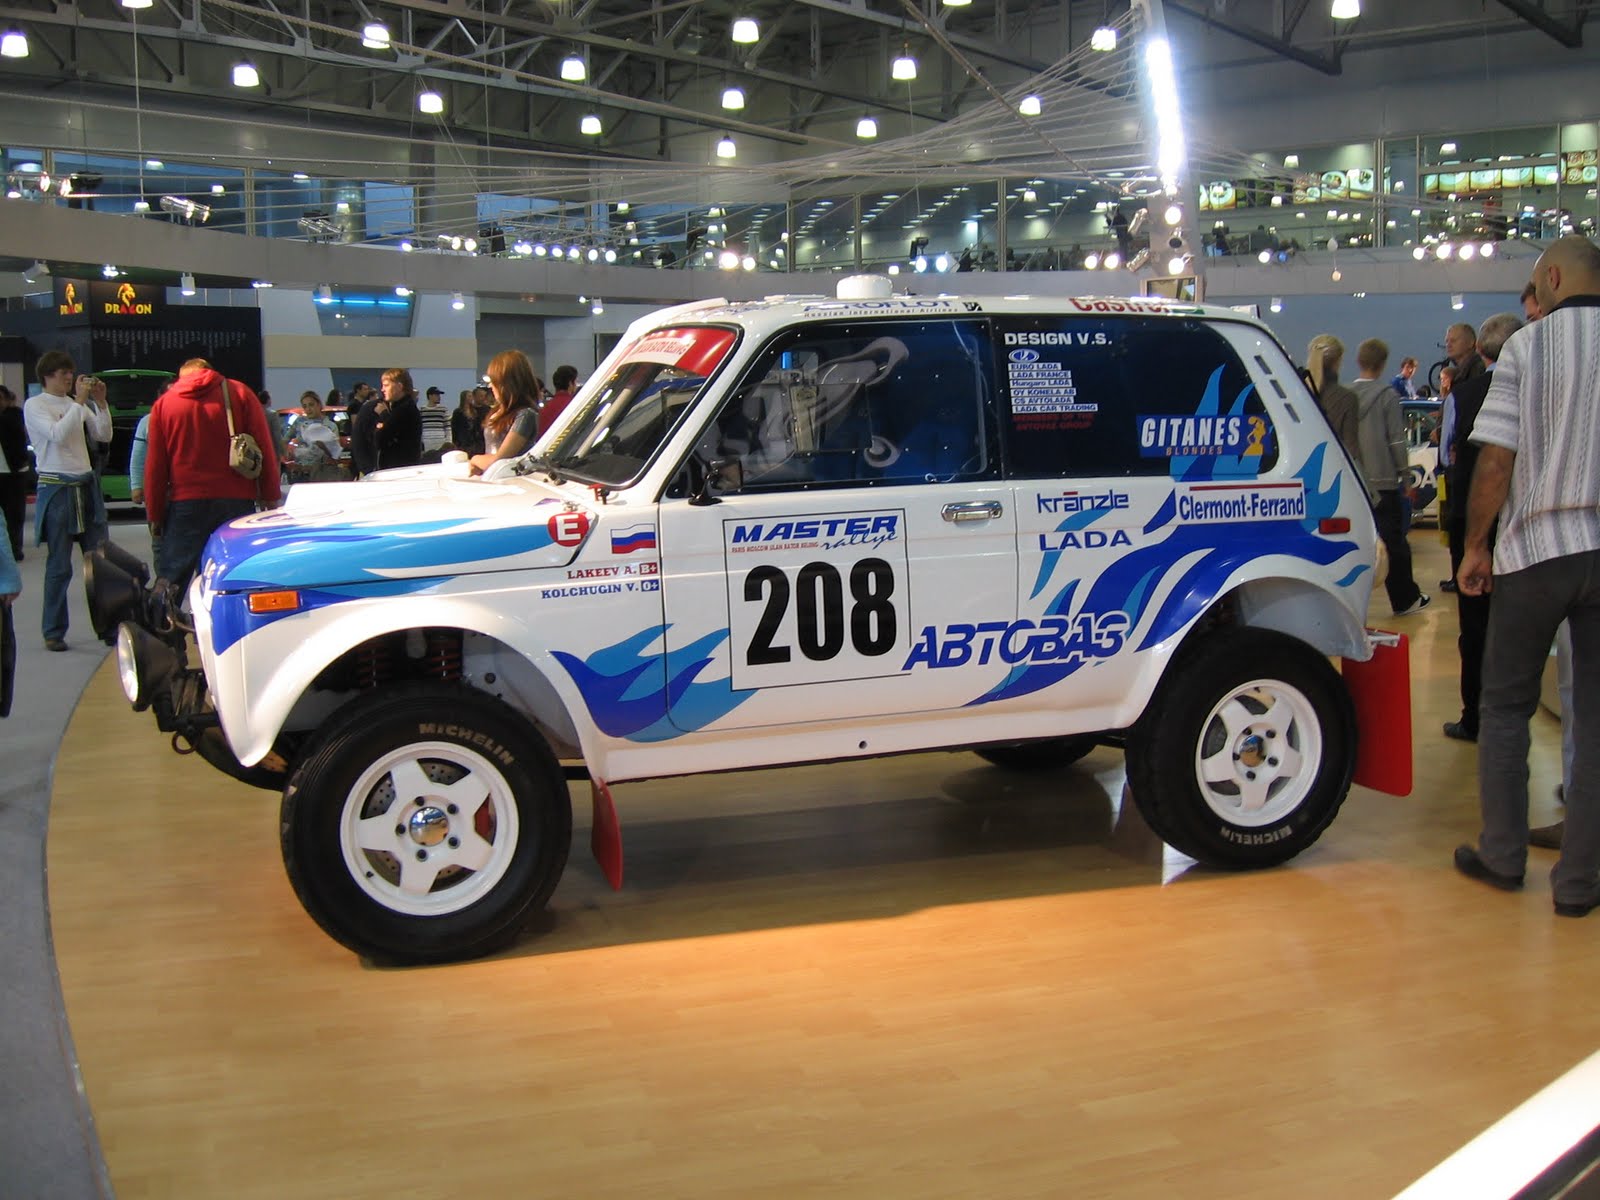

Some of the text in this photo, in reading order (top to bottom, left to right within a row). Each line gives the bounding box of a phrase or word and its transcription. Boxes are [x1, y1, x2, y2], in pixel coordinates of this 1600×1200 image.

[104, 302, 152, 315] DRAGON
[804, 300, 952, 312] AROFLOT
[1004, 332, 1112, 345] DESIGN V.S.
[1141, 416, 1241, 448] GITANES
[1166, 445, 1223, 456] BLONDES
[1179, 491, 1304, 521] Clermont-Ferrand
[732, 515, 898, 543] MASTER
[820, 527, 898, 550] rallye
[1039, 529, 1132, 551] LADA
[568, 566, 619, 580] LAKEEV
[541, 583, 622, 599] KOLCHUGIN
[744, 557, 897, 666] 208
[419, 722, 515, 766] MICHELIN
[1220, 825, 1293, 845] MICHELIN
